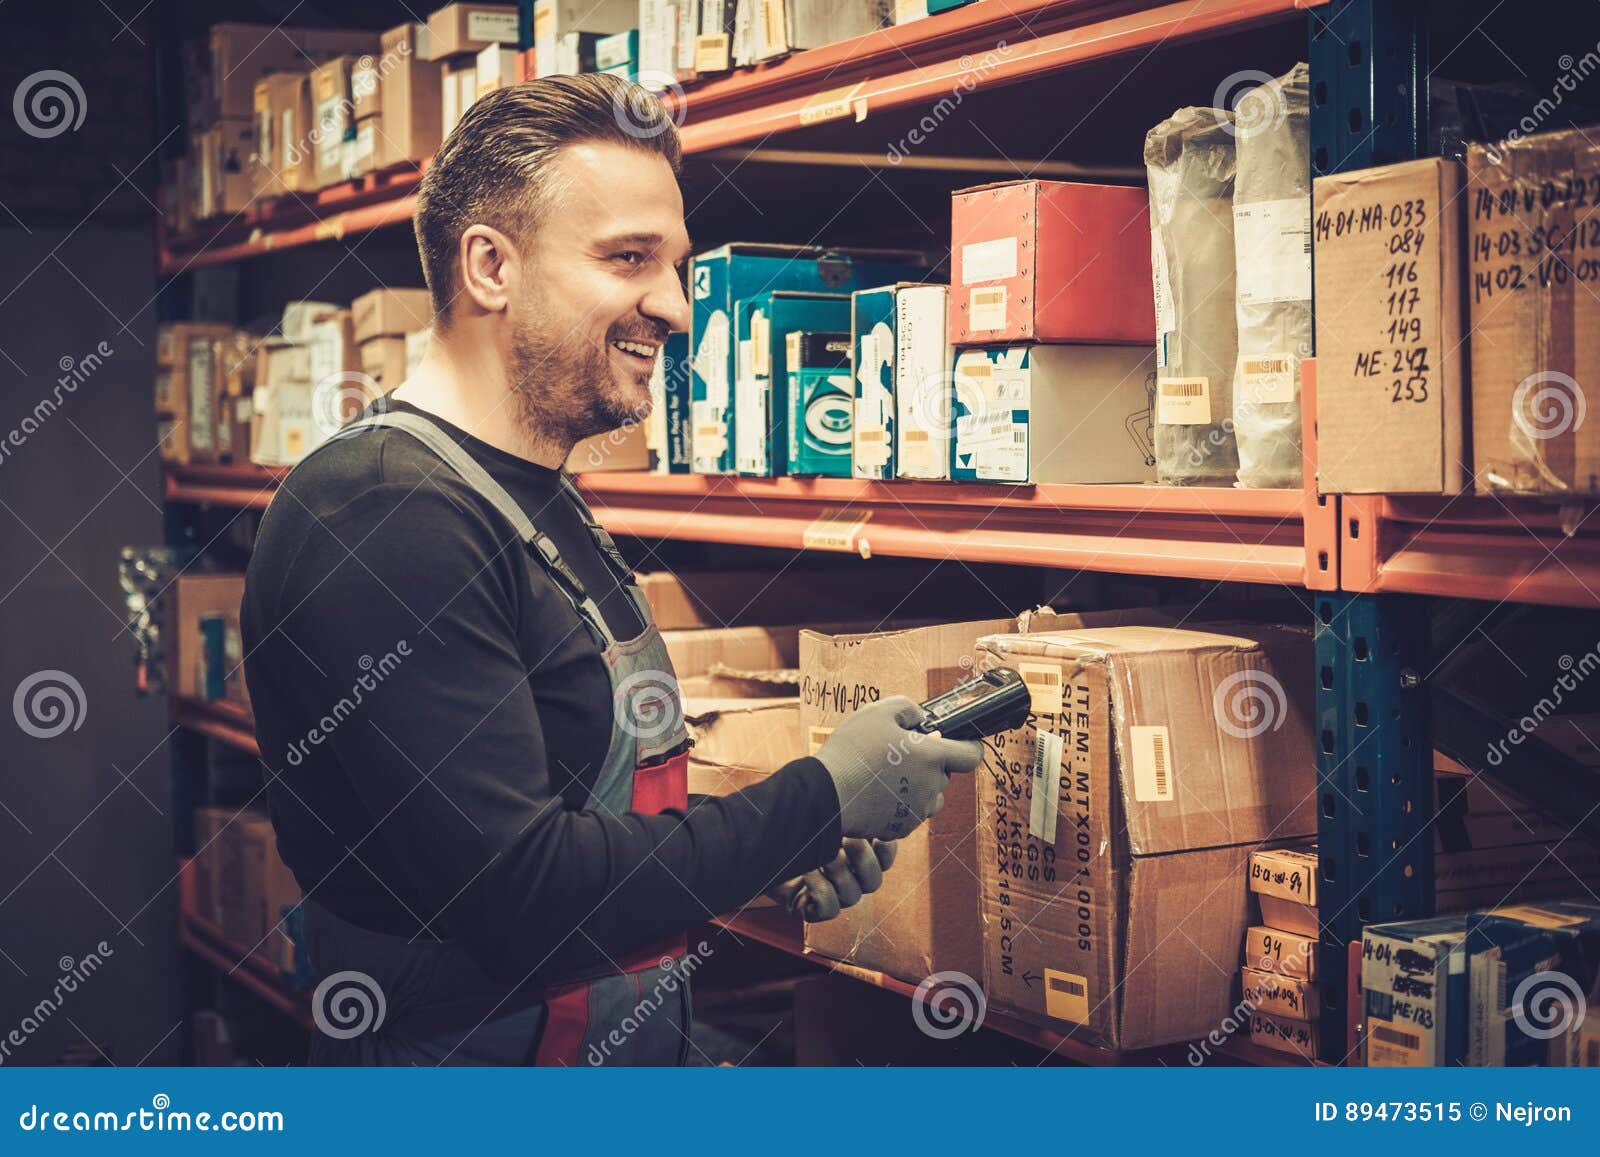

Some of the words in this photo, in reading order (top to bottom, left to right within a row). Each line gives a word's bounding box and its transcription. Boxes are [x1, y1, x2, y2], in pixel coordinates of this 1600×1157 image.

[1075, 684, 1090, 762] ITEM:
[1059, 761, 1072, 804] 701
[1010, 821, 1023, 879] KGS
[1044, 846, 1056, 883] CS
[1076, 771, 1092, 952] MTX001.0005
